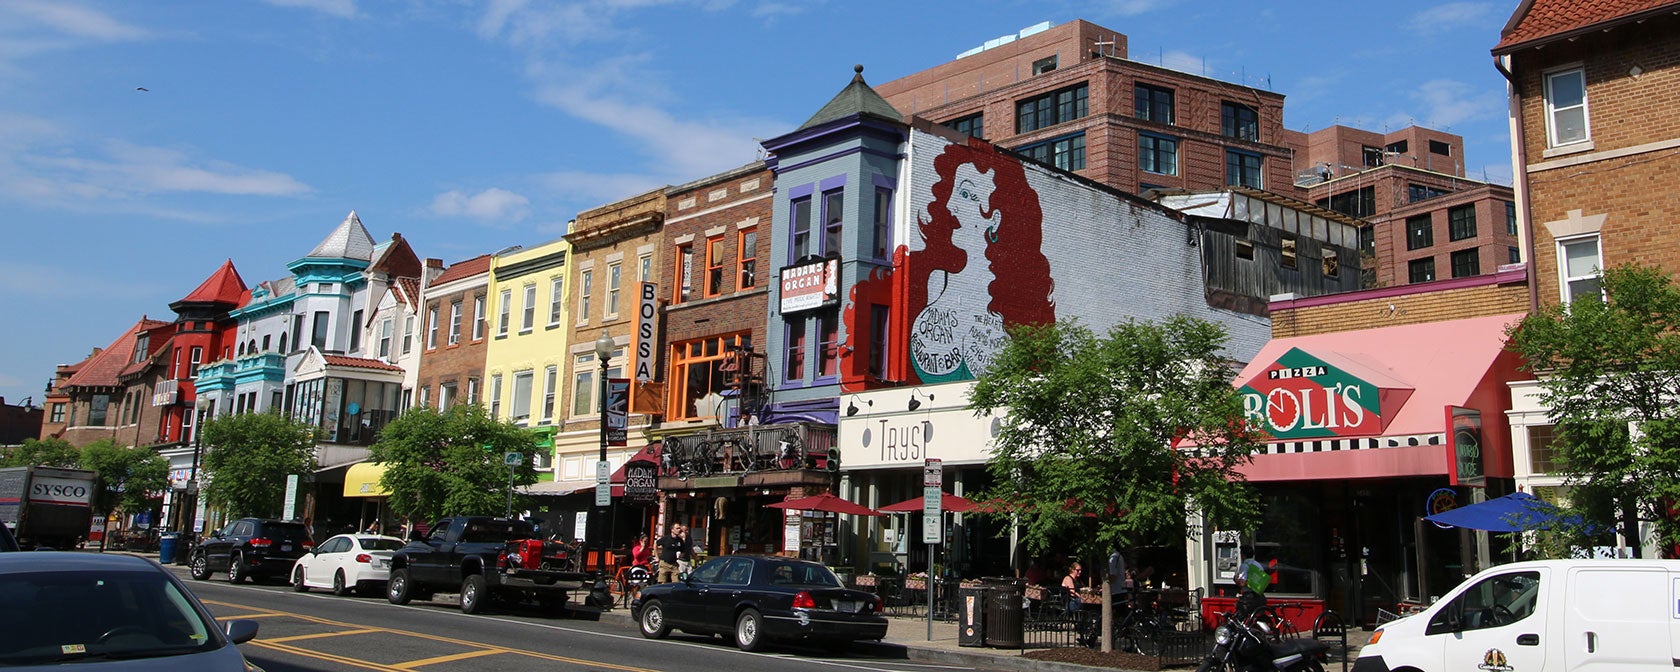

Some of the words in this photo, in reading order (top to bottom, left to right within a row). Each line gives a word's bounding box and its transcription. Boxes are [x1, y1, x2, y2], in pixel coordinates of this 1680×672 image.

[784, 275, 820, 292] ORGAN
[637, 284, 655, 378] BOSSA
[919, 321, 954, 344] ORGAN
[943, 347, 962, 369] BAR
[1270, 367, 1326, 379] PIZZA
[606, 384, 628, 430] EAT
[1244, 382, 1364, 433] BOLI'S
[33, 484, 86, 498] SYSCO
[627, 478, 656, 488] ORGAN
